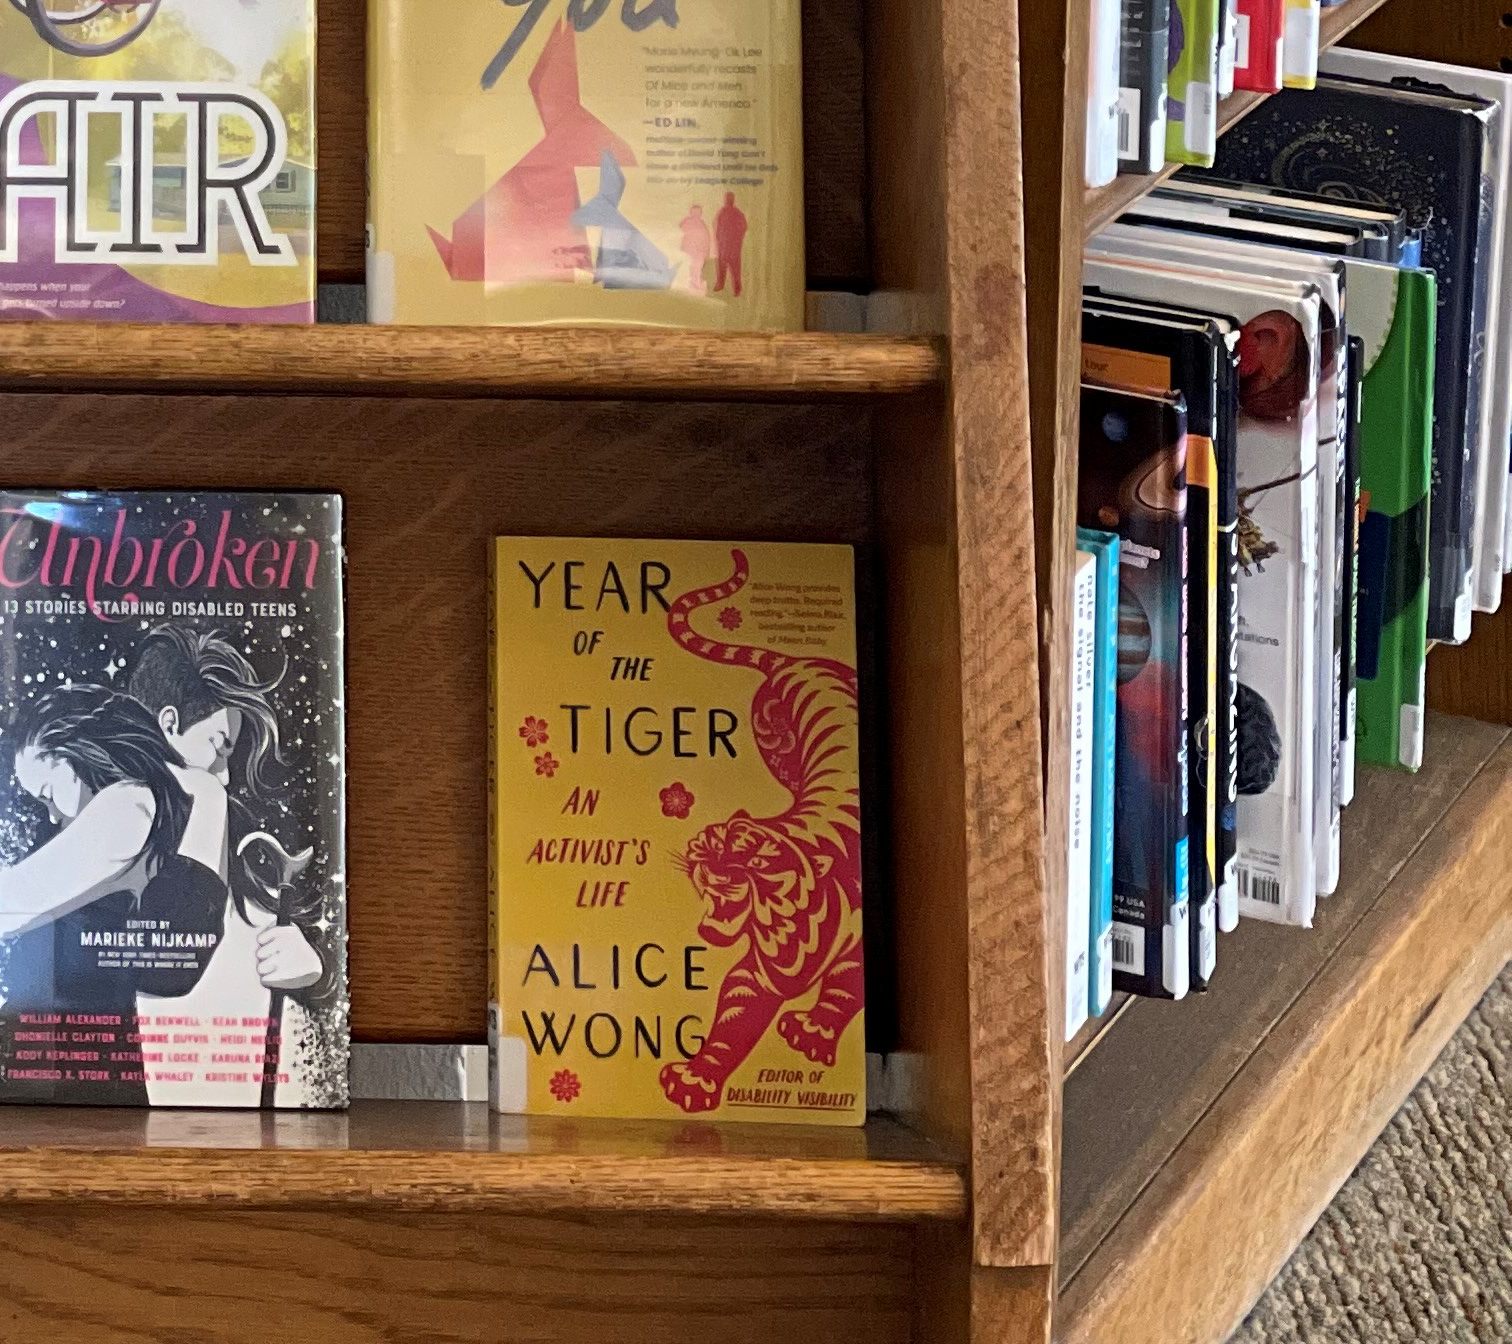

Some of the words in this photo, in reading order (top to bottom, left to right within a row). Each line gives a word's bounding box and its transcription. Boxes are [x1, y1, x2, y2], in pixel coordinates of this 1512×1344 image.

[519, 560, 672, 614] YEAR
[4, 600, 19, 613] 13
[25, 600, 87, 616] STORIES
[93, 600, 167, 616] STARRING
[173, 601, 245, 617] DISABLED
[250, 603, 298, 617] TEENS
[574, 630, 604, 656] OF
[610, 656, 654, 682] THE
[560, 704, 739, 759] TIGER
[562, 786, 600, 816] AN
[526, 838, 652, 866] ACTIVIST'S
[576, 880, 631, 908] LIFE
[127, 920, 156, 930] EDITED
[160, 921, 170, 930] BY
[80, 932, 145, 947] MARIEKE
[152, 934, 217, 948] NIJKAMP
[522, 943, 710, 991] ALICE
[522, 1010, 708, 1060] WONG
[758, 1068, 806, 1085] EDITOR
[810, 1069, 826, 1084] OF
[727, 1086, 791, 1105] DISABILITY
[796, 1090, 857, 1107] VISIBILITY
